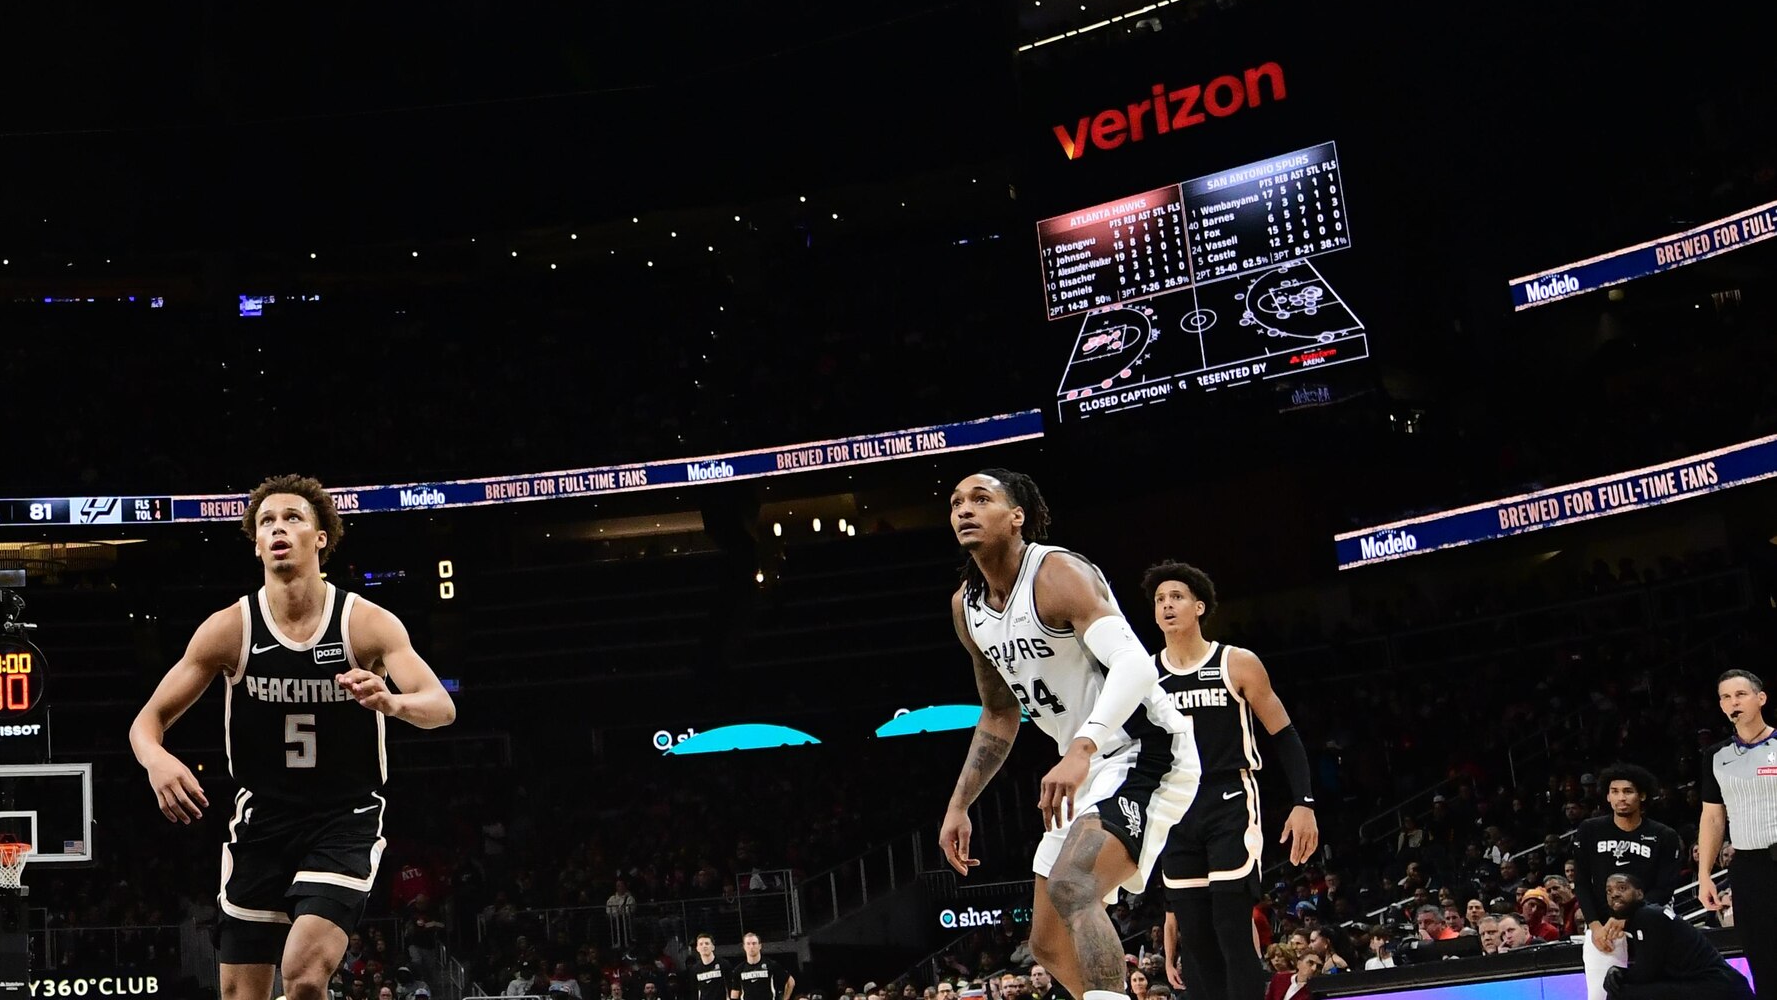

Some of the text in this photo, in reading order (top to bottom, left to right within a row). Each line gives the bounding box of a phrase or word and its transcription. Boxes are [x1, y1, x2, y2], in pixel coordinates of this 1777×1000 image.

[1053, 61, 1287, 161] verizon
[1207, 154, 1309, 190] SAN ANTONIO SPURS
[1259, 160, 1337, 189] PTS REB AST STL FLS
[1070, 199, 1147, 227] ATLANTA HAWKS
[1200, 193, 1259, 216] Wembanyama
[1109, 220, 1122, 228] PTS
[1138, 210, 1151, 221] AST
[1153, 207, 1166, 217] STL
[1167, 202, 1180, 213] FLS
[1202, 212, 1235, 228] Barnes
[1203, 228, 1221, 239] Fox
[1205, 235, 1238, 251] Vassell
[1055, 237, 1096, 254] Okongwu
[1655, 224, 1740, 266] BREWED FOR
[1056, 251, 1092, 267] Johnson
[1195, 269, 1211, 281] 2PT
[1215, 262, 1238, 276] 25-40
[1273, 250, 1290, 262] 3PT
[1320, 236, 1347, 250] 38.1%
[1207, 249, 1236, 263] Castle
[1059, 273, 1096, 289] Risacher
[1525, 274, 1579, 303] Modelo
[1050, 307, 1064, 316] 2PT
[1122, 287, 1136, 299] 3PT
[1060, 285, 1093, 300] Daniels
[1079, 395, 1119, 413] CLOSED
[1197, 369, 1250, 387] RESENTED
[1251, 362, 1267, 375] BY
[775, 431, 947, 471] BREWED FOR FULL-TIME FANS
[687, 460, 734, 482] Modelo
[484, 469, 648, 500] BREWED FOR FULL-TIME FANS
[135, 499, 160, 510] FLS 1
[332, 493, 359, 511] FANS
[400, 489, 445, 507] Modelo
[1498, 461, 1719, 531] BREWED FOR FULL-TIME FANS
[29, 503, 52, 520] 81
[135, 510, 161, 521] TOL 4
[200, 500, 245, 517] BREWED
[1360, 530, 1417, 561] Modelo
[439, 560, 453, 578] 0
[440, 581, 454, 599] 0
[316, 647, 342, 660] paze
[1011, 677, 1068, 719] 24
[285, 714, 316, 768] 5
[1597, 840, 1651, 858] SPURS
